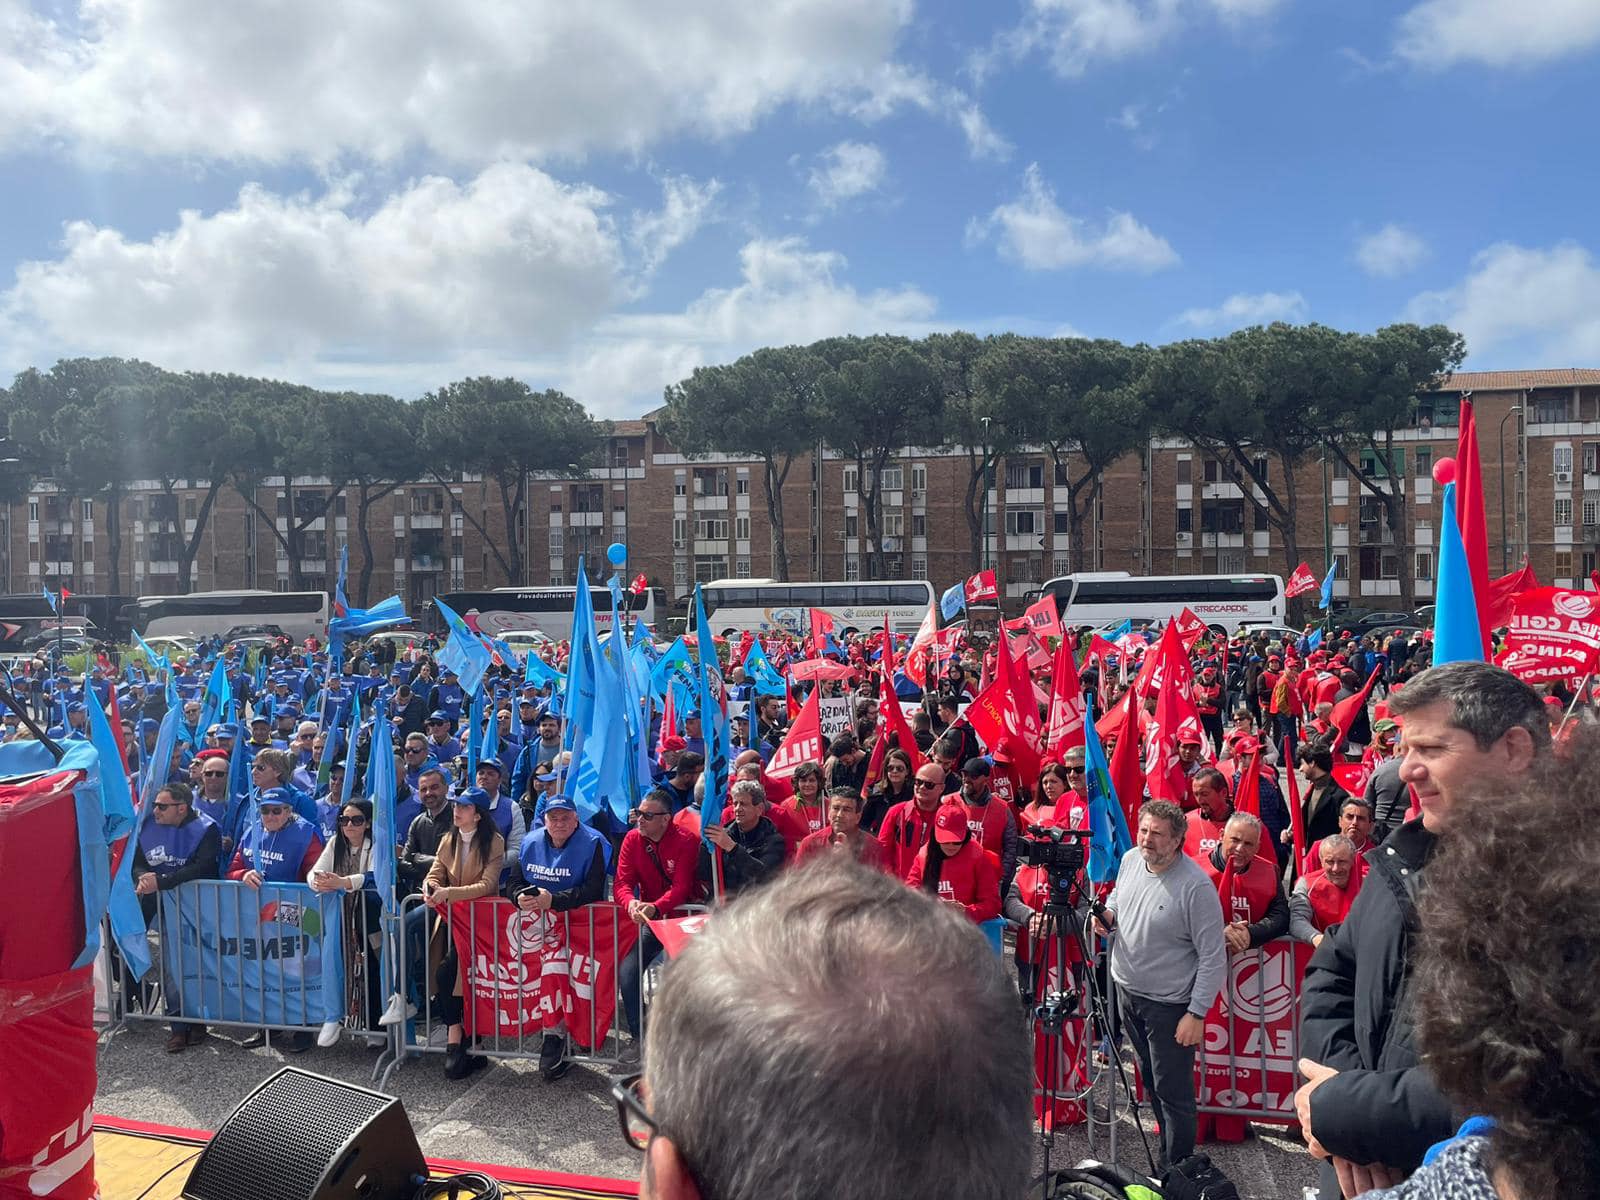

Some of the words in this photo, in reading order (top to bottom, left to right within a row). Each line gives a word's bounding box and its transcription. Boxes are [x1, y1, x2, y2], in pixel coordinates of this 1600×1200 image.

[1194, 605, 1248, 613] STRECAPEDE
[967, 820, 984, 830] GIL
[526, 862, 572, 878] FENEALUIL
[1231, 895, 1250, 908] GIL
